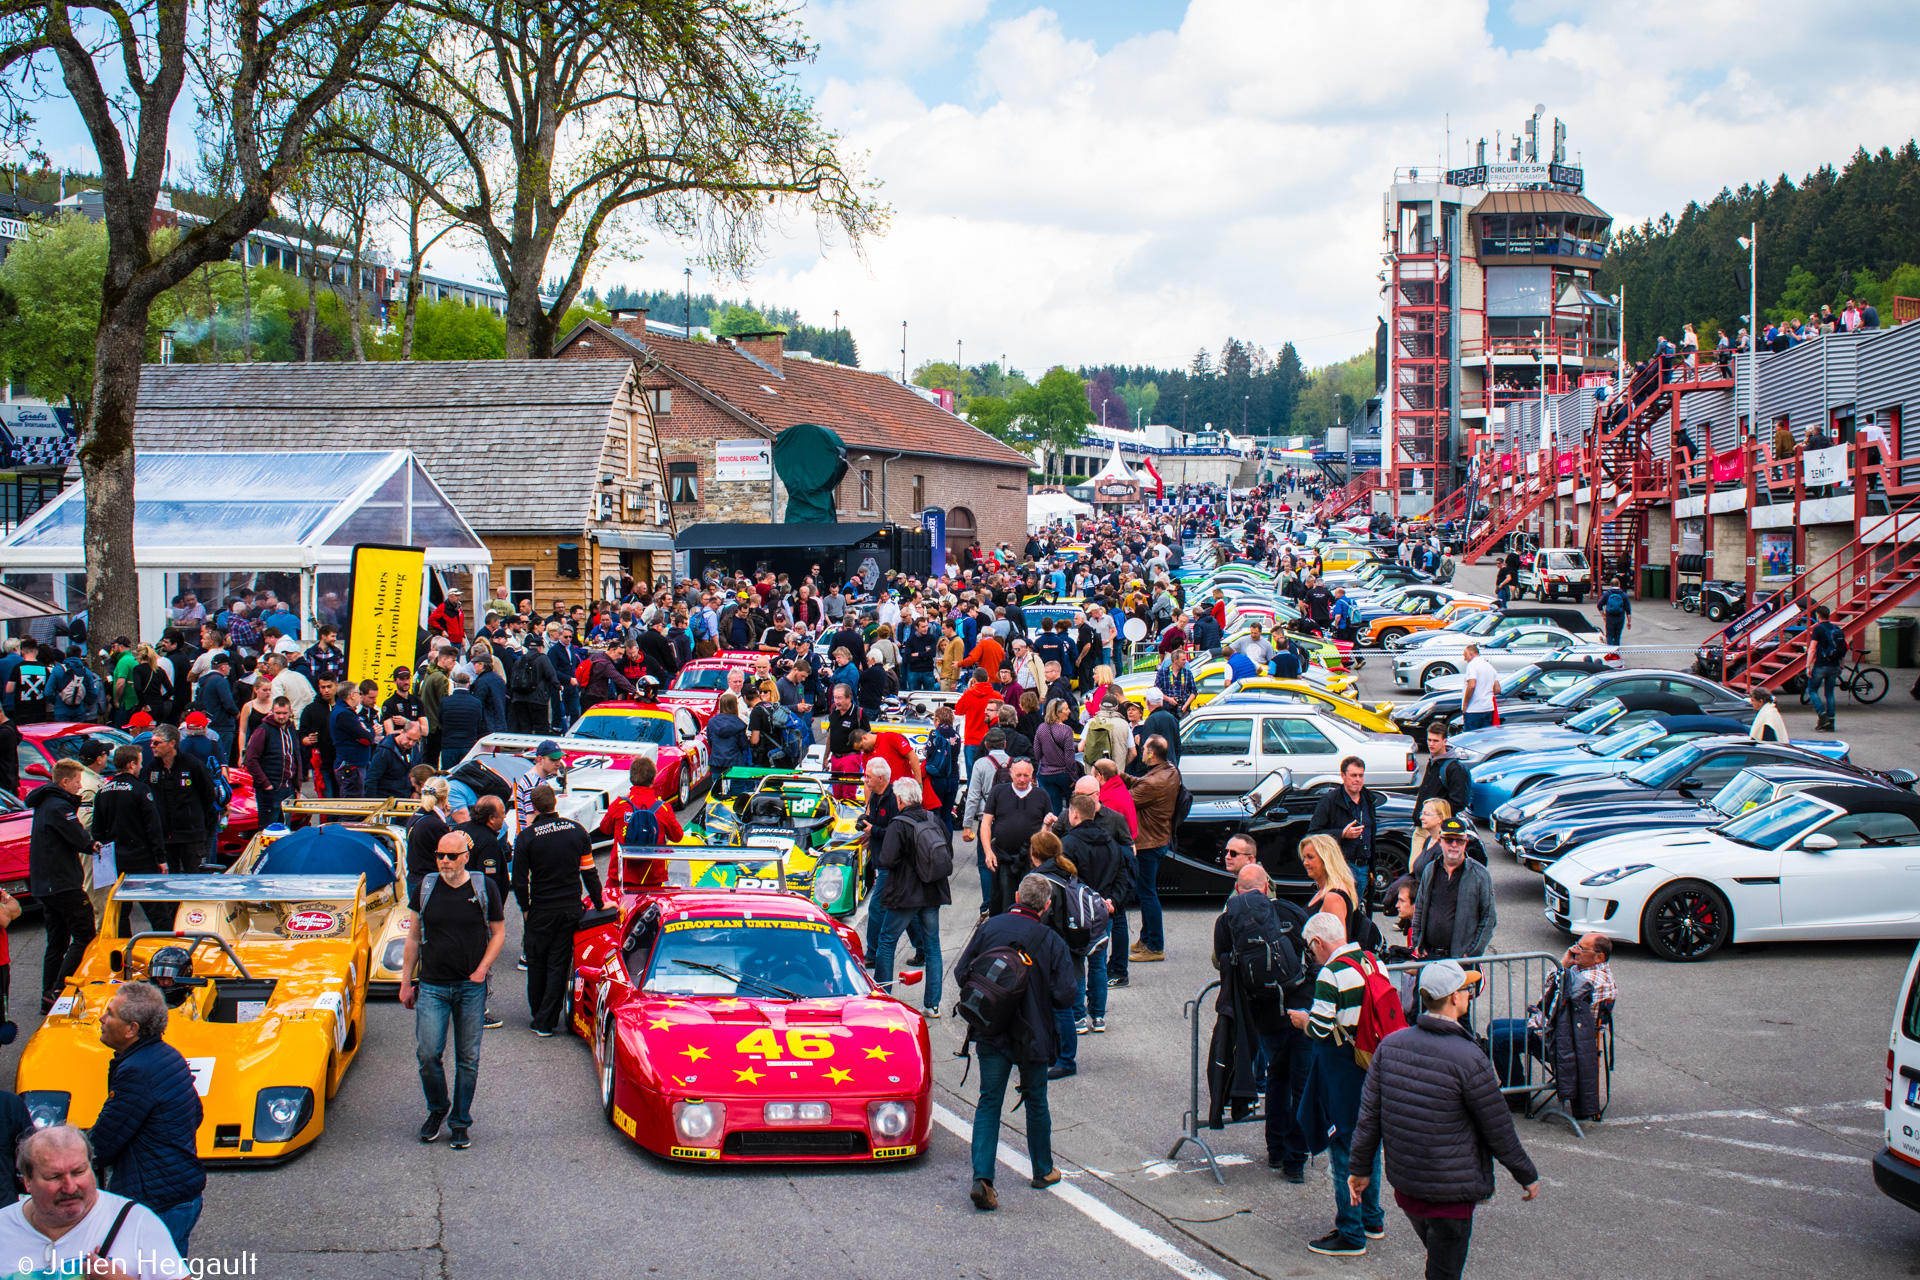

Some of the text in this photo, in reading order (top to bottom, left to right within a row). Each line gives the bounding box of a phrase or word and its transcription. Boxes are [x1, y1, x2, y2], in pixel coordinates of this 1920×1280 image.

[1555, 166, 1581, 184] 12:28
[1811, 467, 1834, 479] ZENITH
[386, 573, 407, 657] Luxembourg
[371, 572, 389, 681] rchamps Motors
[791, 798, 816, 813] BP
[663, 919, 832, 935] EUROPEAN UNIVERSITY
[736, 1028, 835, 1060] 46
